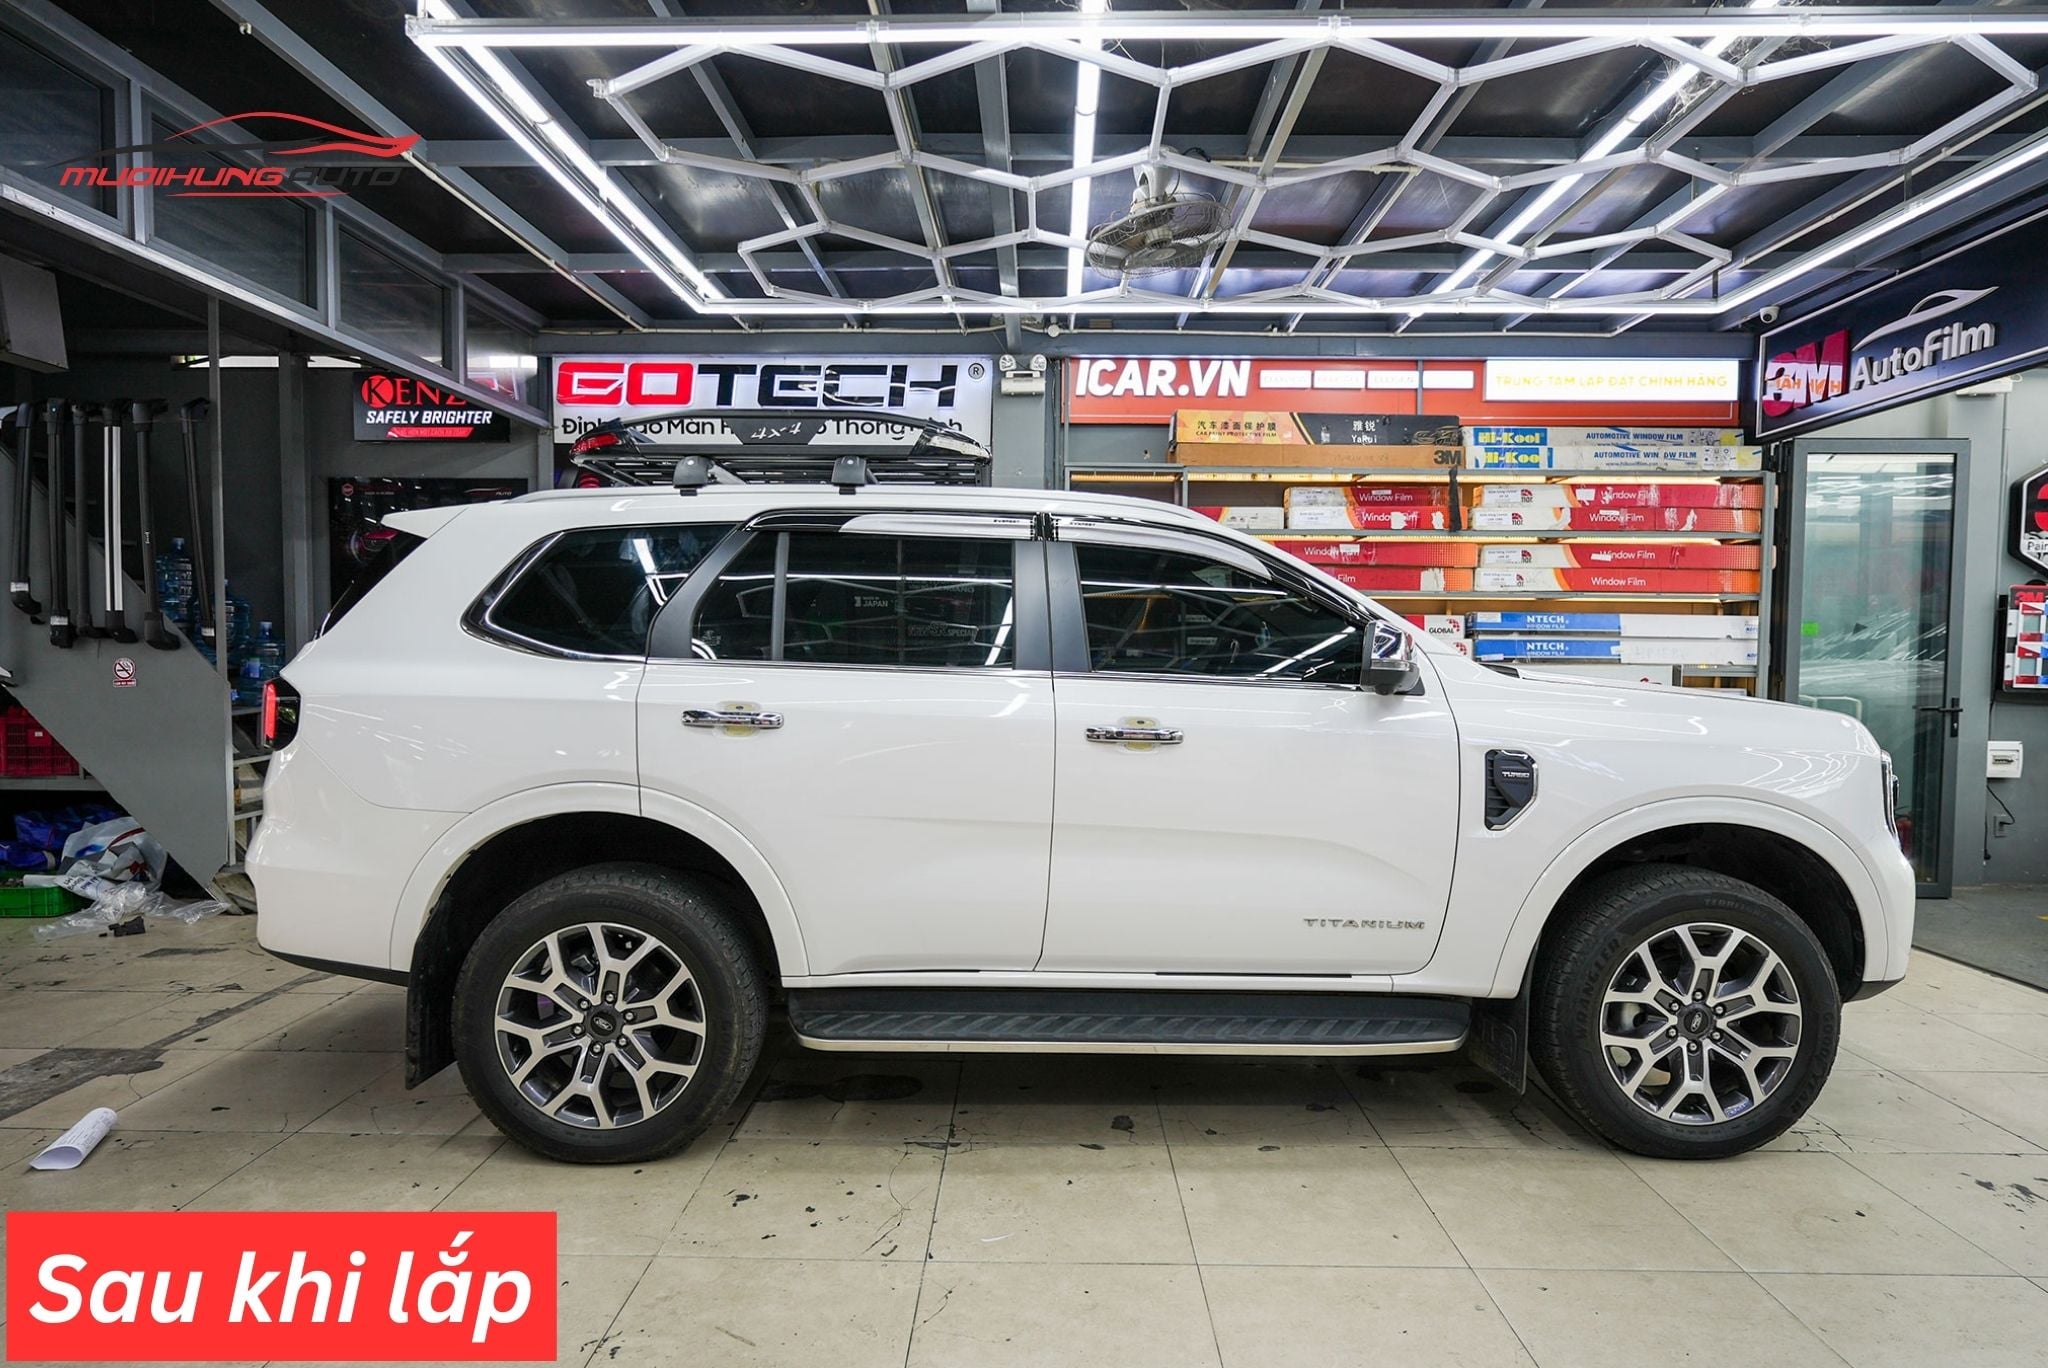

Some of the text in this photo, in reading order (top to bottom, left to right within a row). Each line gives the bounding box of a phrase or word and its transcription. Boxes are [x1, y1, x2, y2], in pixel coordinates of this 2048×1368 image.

[1762, 322, 1997, 417] 3M AutoFilm
[1075, 358, 1251, 397] ICAR.VN
[556, 361, 959, 407] GOTECH
[366, 411, 493, 424] SAFELY BRIGHTER
[1586, 432, 1631, 440] AUTOMOTIVE
[1433, 449, 1462, 466] 3M
[1594, 451, 1640, 459] AUTOMOTIVE
[1360, 493, 1413, 502] Window Film
[1361, 511, 1392, 521] Windo
[1626, 513, 1645, 522] Film
[1637, 550, 1656, 559] Film
[1337, 574, 1356, 583] Film
[1591, 577, 1647, 586] Window Film
[1303, 917, 1426, 930] TITANIUM
